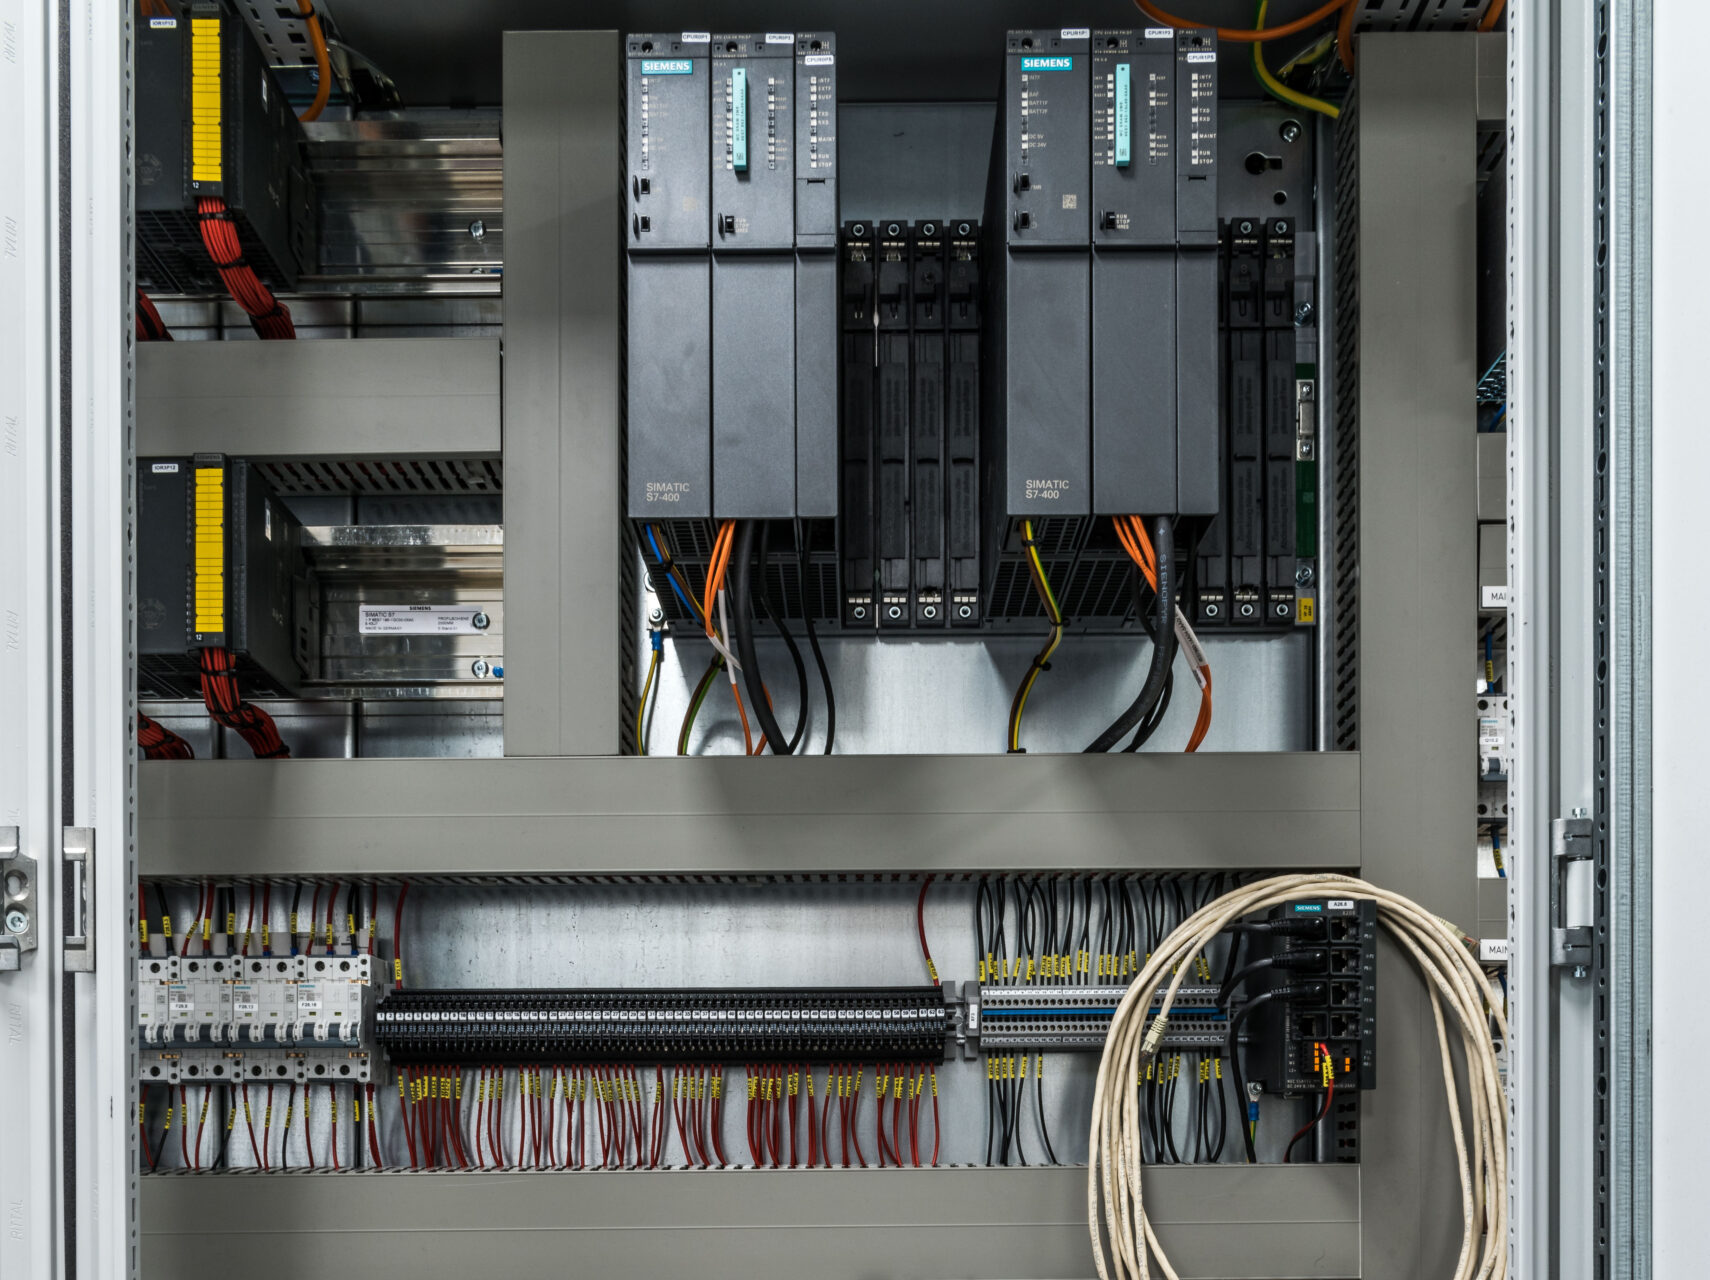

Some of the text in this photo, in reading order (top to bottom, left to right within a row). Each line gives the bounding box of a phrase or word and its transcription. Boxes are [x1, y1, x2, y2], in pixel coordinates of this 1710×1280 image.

[644, 62, 690, 71] SIEMENS
[1024, 59, 1070, 67] SIEMENS
[646, 482, 690, 492] SIMATIC
[1025, 480, 1069, 489] SIMATIC
[646, 492, 680, 502] S7-400
[1025, 490, 1059, 499] S7-400
